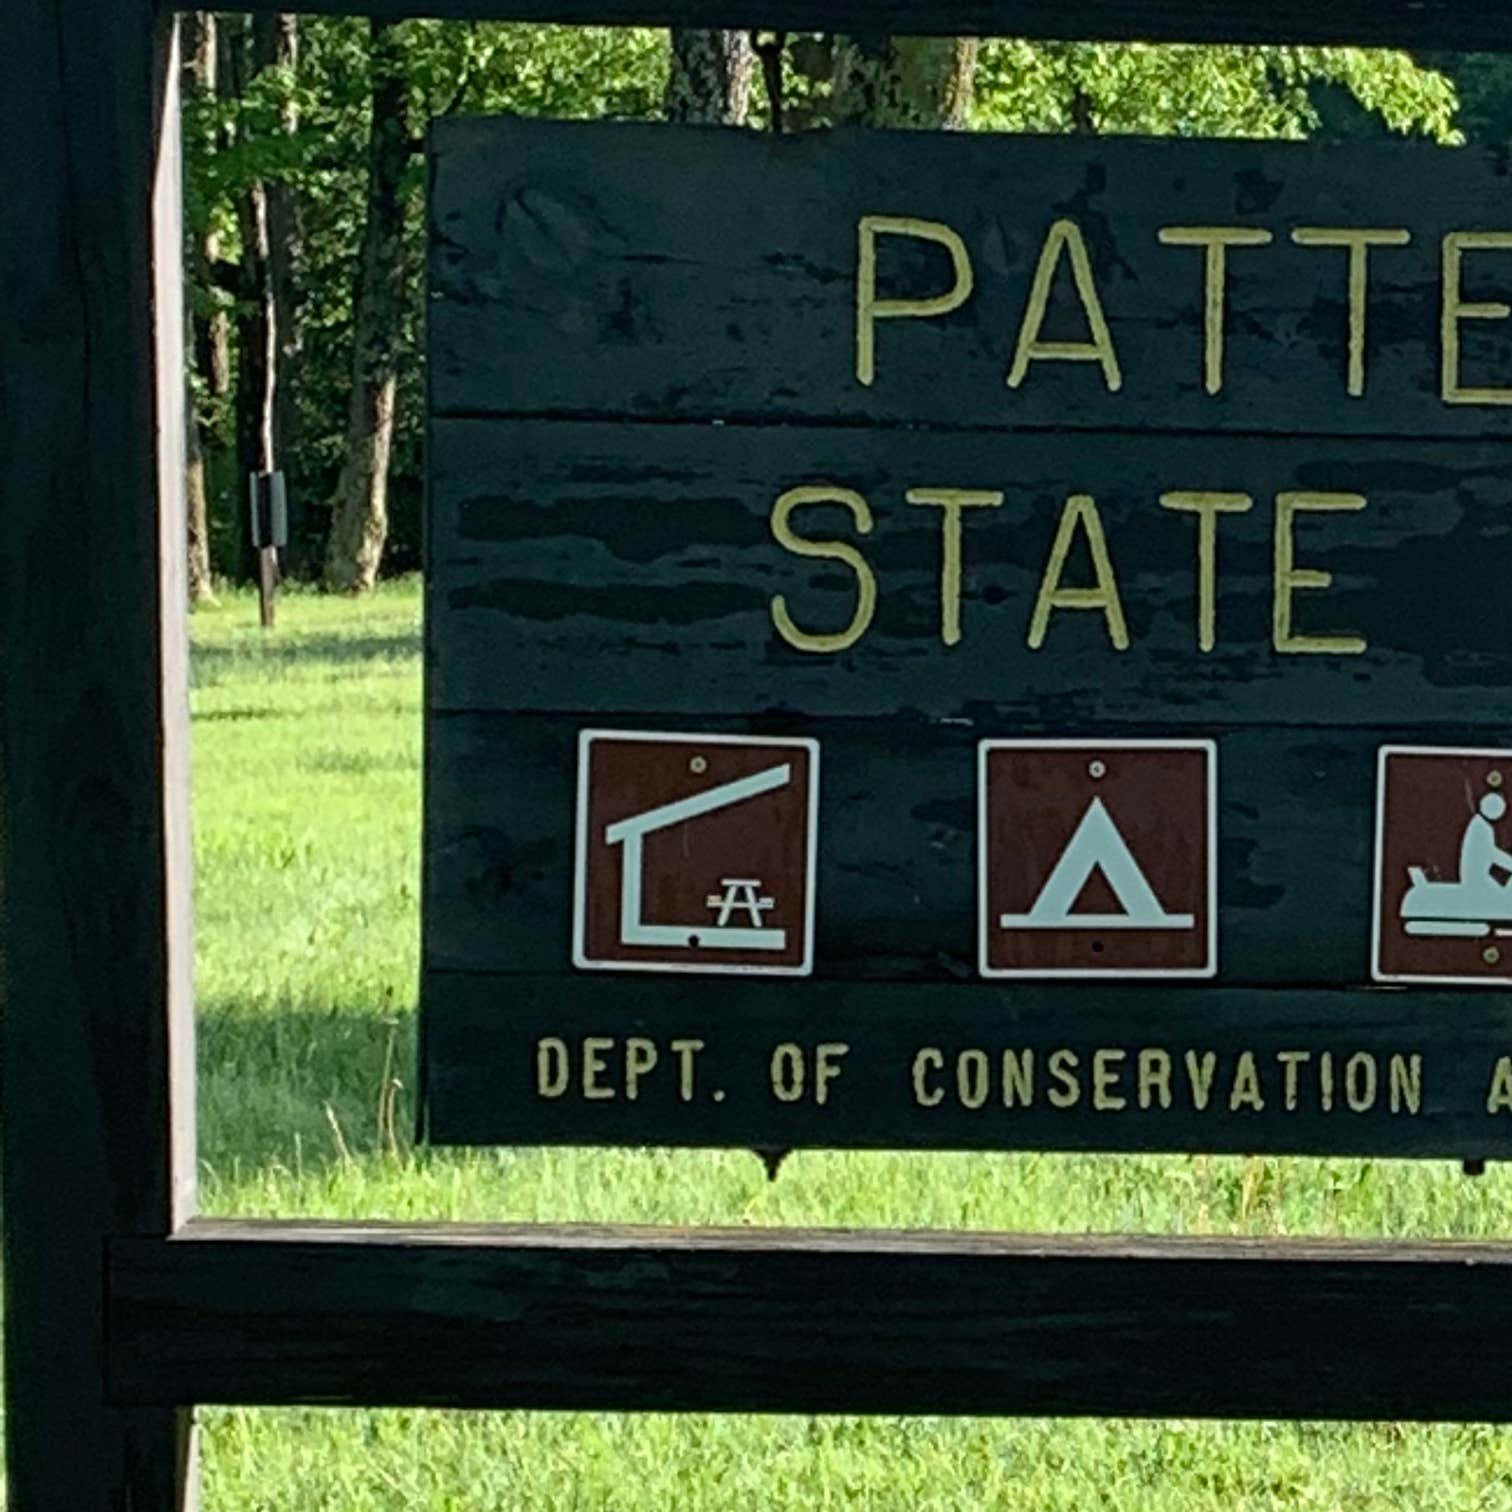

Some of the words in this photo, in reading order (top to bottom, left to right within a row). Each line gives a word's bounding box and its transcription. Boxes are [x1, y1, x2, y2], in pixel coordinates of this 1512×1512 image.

[768, 484, 1369, 657] STATE
[536, 1037, 728, 1103] DEPT.
[770, 1043, 850, 1106] OF
[910, 1046, 1423, 1115] CONSERVATION
